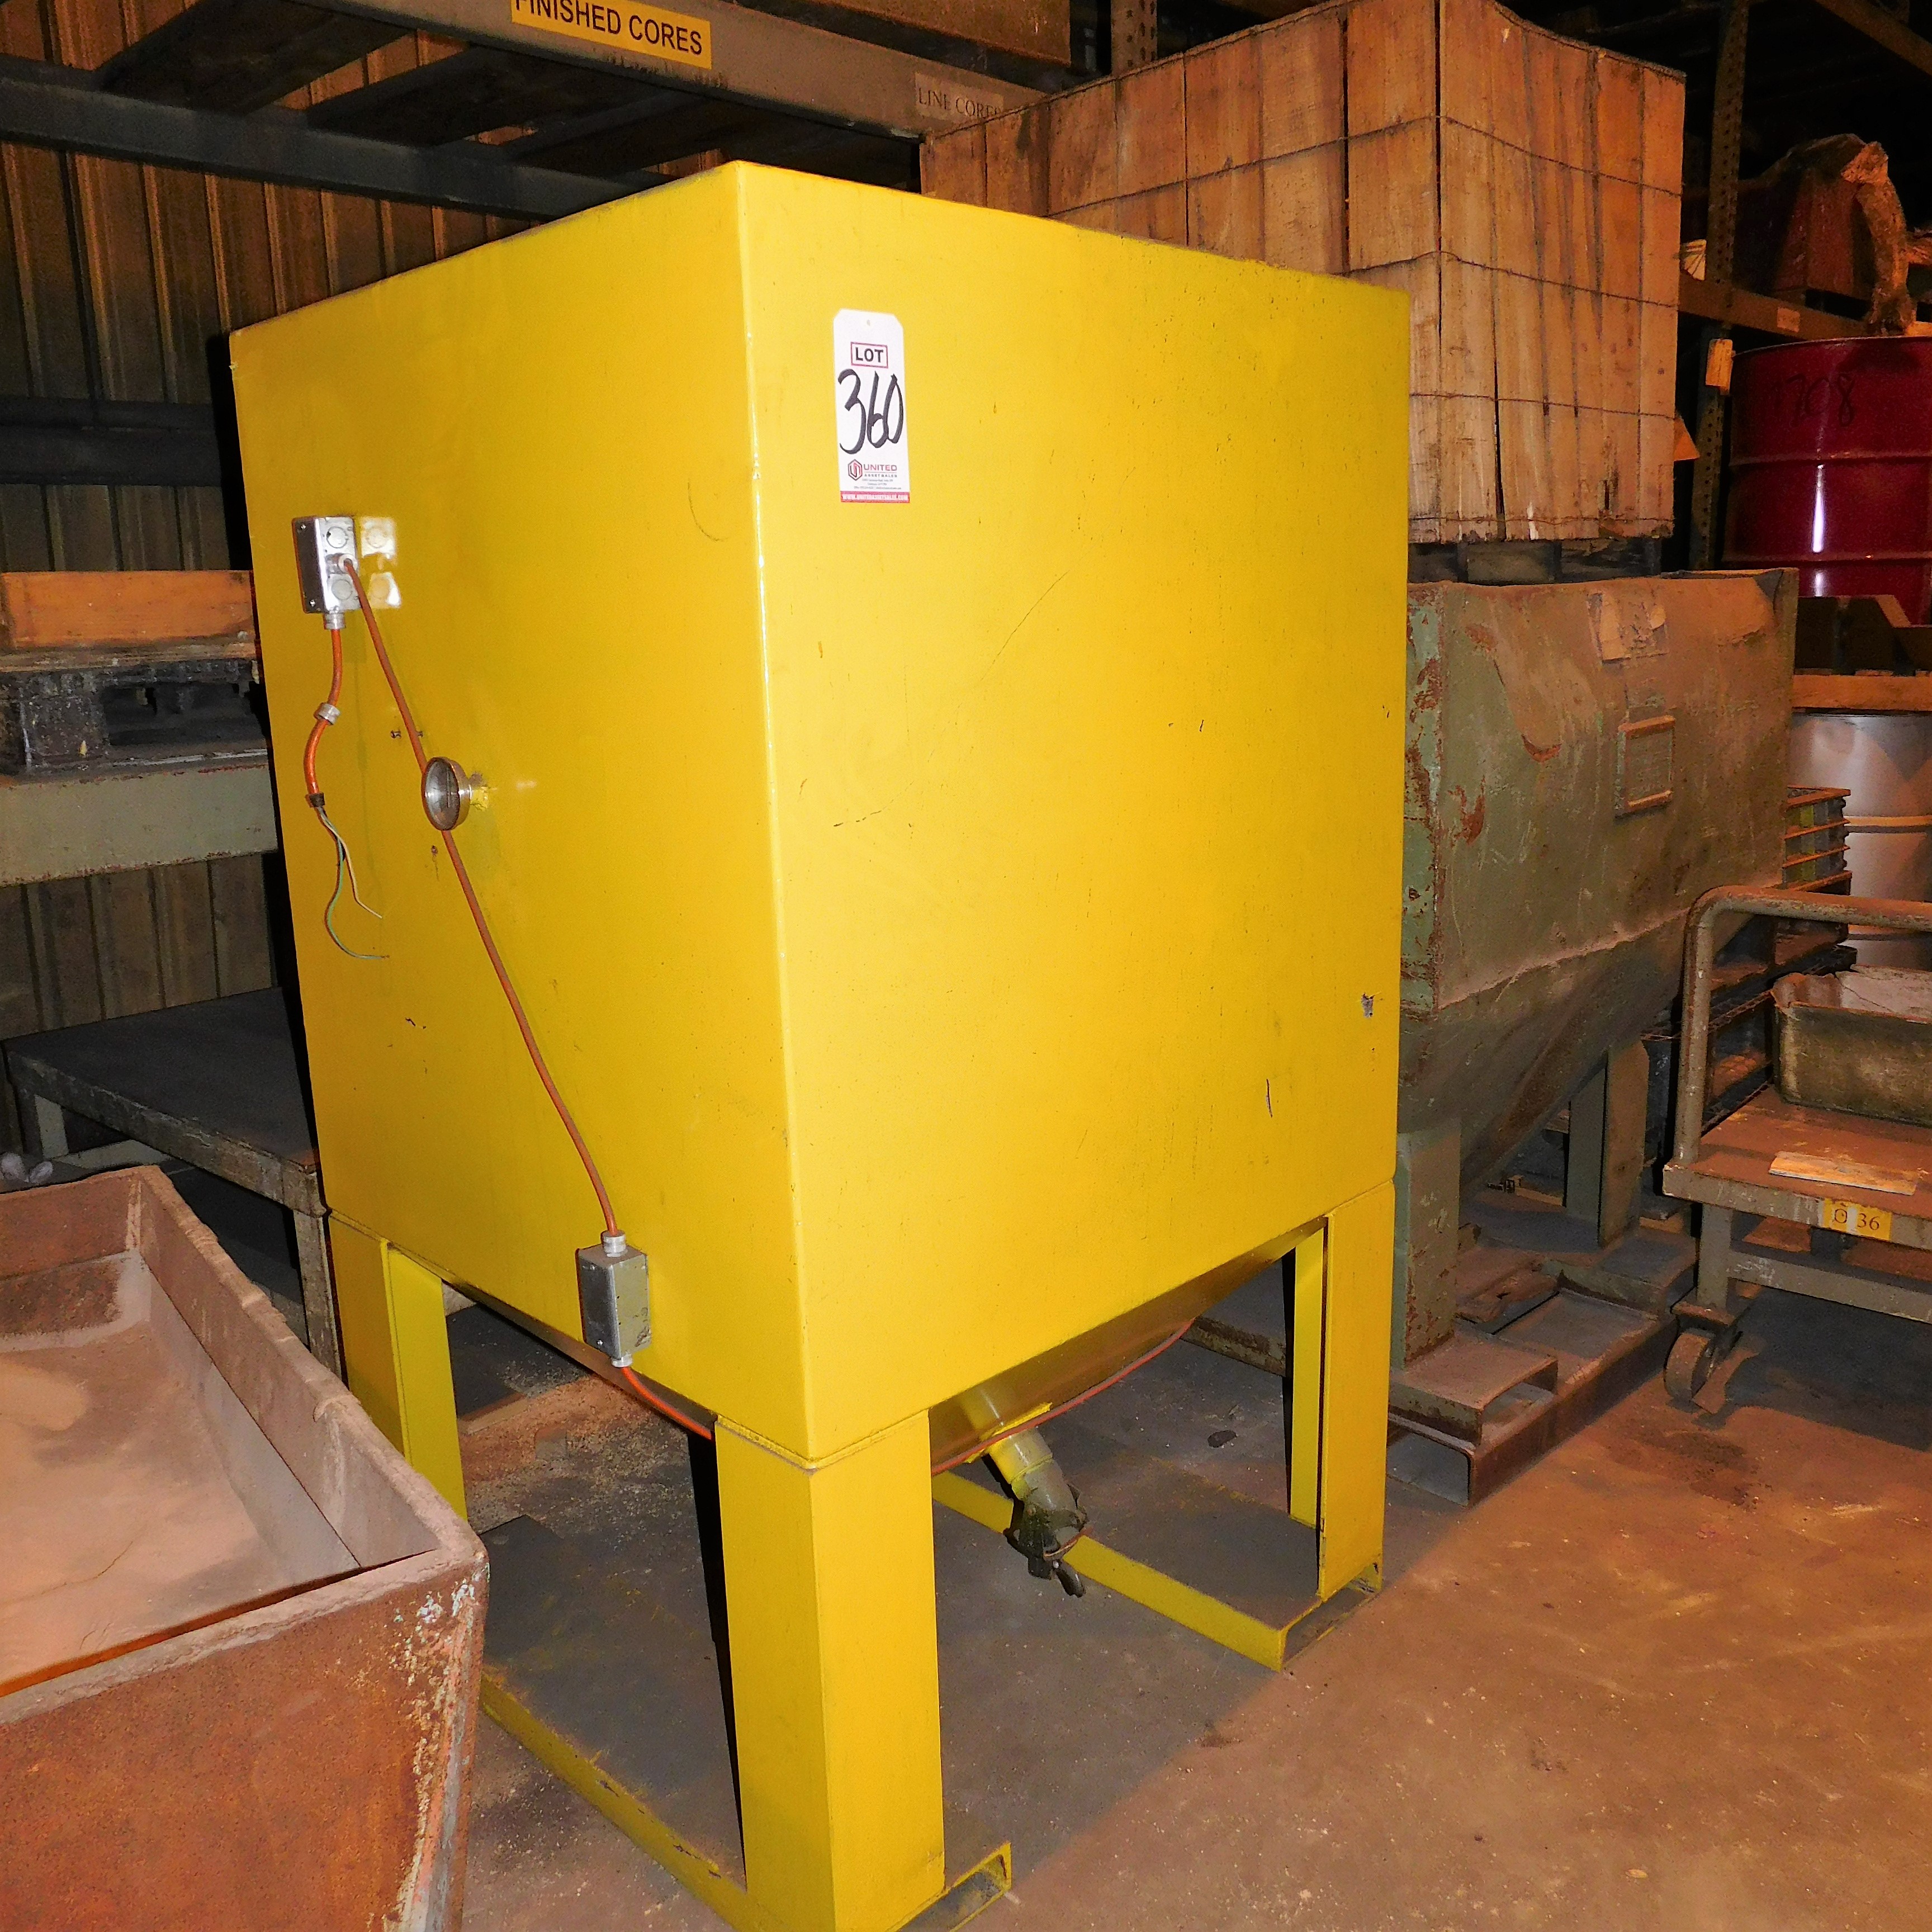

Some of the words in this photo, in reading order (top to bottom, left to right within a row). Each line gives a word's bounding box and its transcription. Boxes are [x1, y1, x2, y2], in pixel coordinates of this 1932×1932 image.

[629, 15, 702, 55] CORES
[855, 347, 884, 363] LOT
[837, 368, 904, 454] 360
[1857, 1213, 1879, 1230] 36
